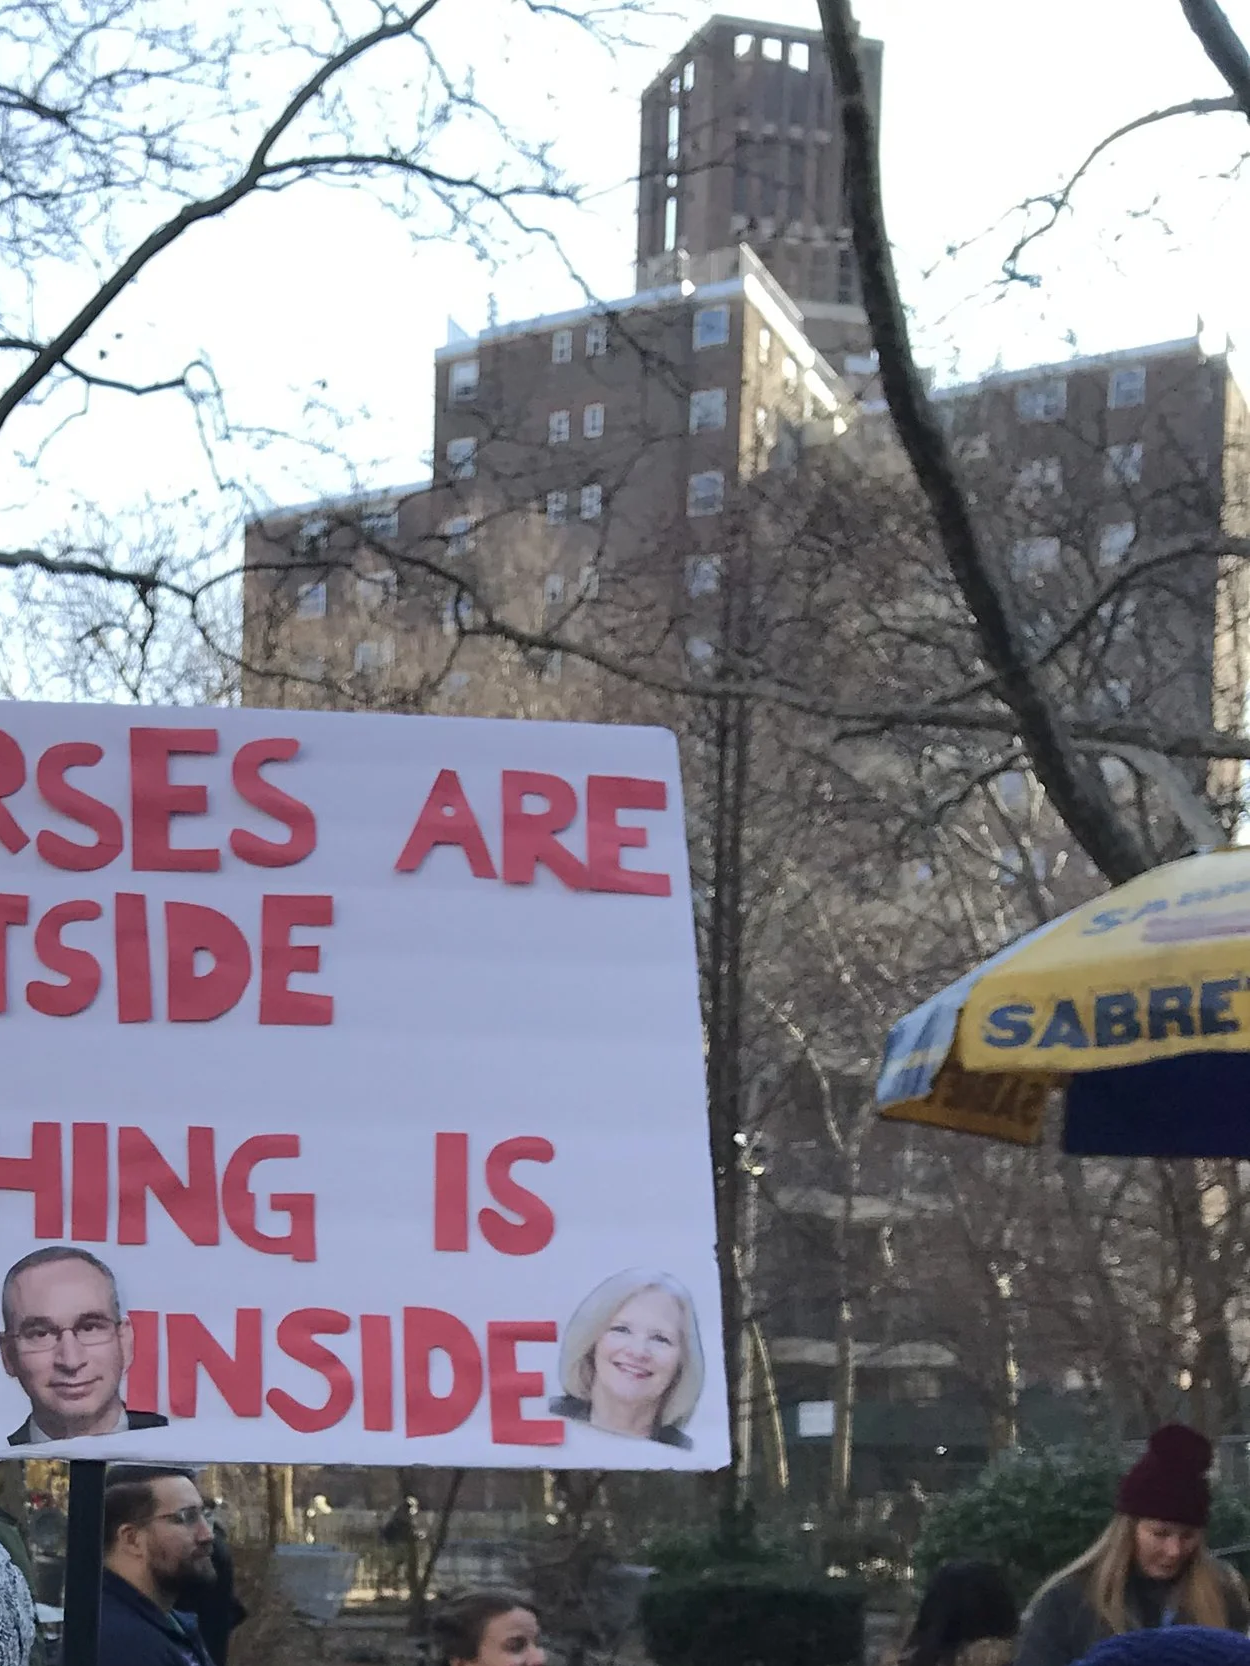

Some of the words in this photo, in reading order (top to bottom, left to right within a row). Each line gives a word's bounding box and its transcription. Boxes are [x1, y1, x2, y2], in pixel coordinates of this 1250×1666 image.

[397, 770, 670, 895] ARE
[982, 976, 1250, 1050] SABRE
[435, 1133, 555, 1255] IS
[127, 1306, 566, 1446] INSIDE
